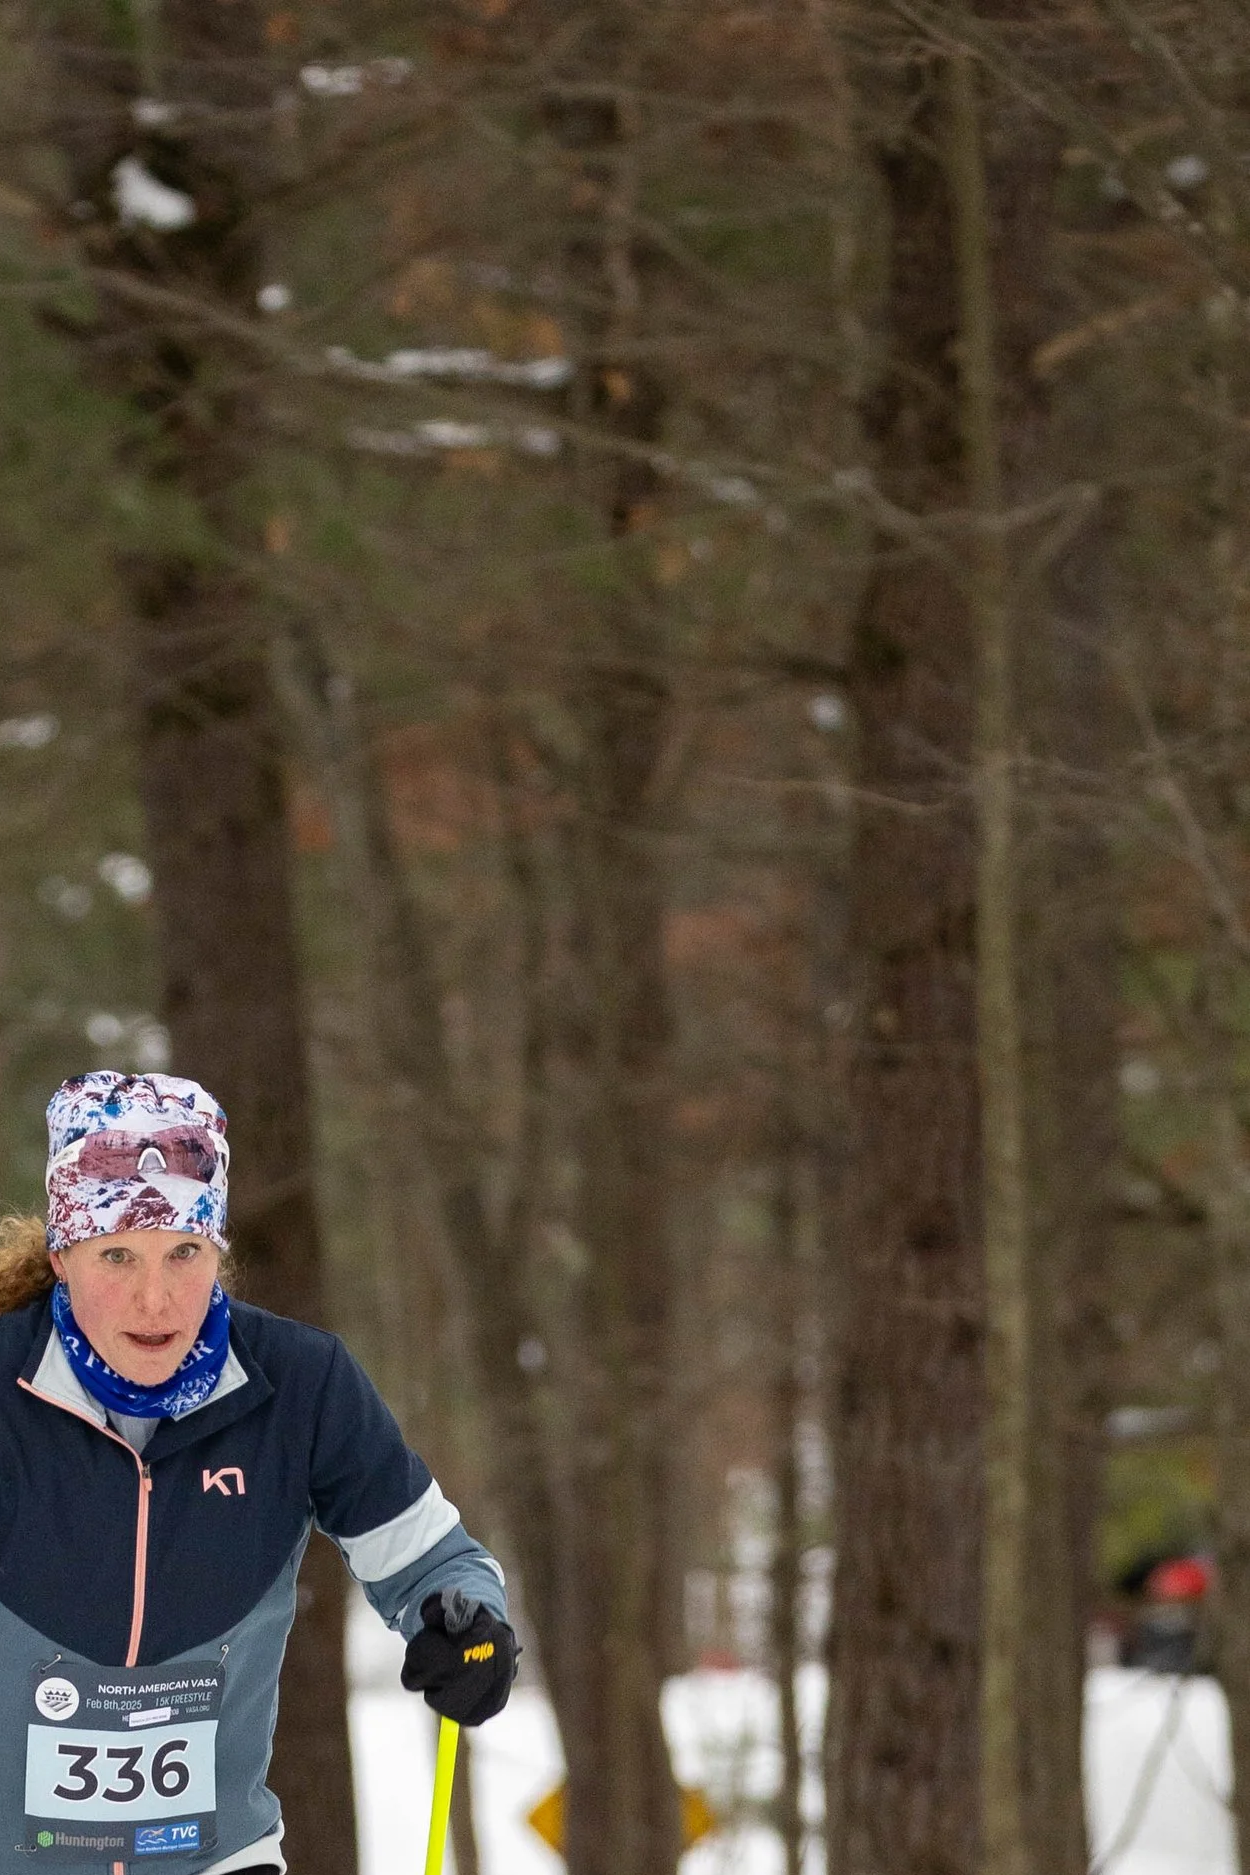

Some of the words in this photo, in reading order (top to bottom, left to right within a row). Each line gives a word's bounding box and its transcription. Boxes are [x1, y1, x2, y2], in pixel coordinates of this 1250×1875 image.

[463, 1641, 495, 1663] TOKO
[98, 1684, 136, 1695] NORTH
[138, 1680, 189, 1694] AMERICAN
[191, 1678, 218, 1688] VASA
[86, 1698, 102, 1709] Feb
[171, 1691, 212, 1705] FREESTYLE
[53, 1739, 190, 1803] 336
[55, 1831, 125, 1851] Huntington
[171, 1825, 198, 1840] TVC
